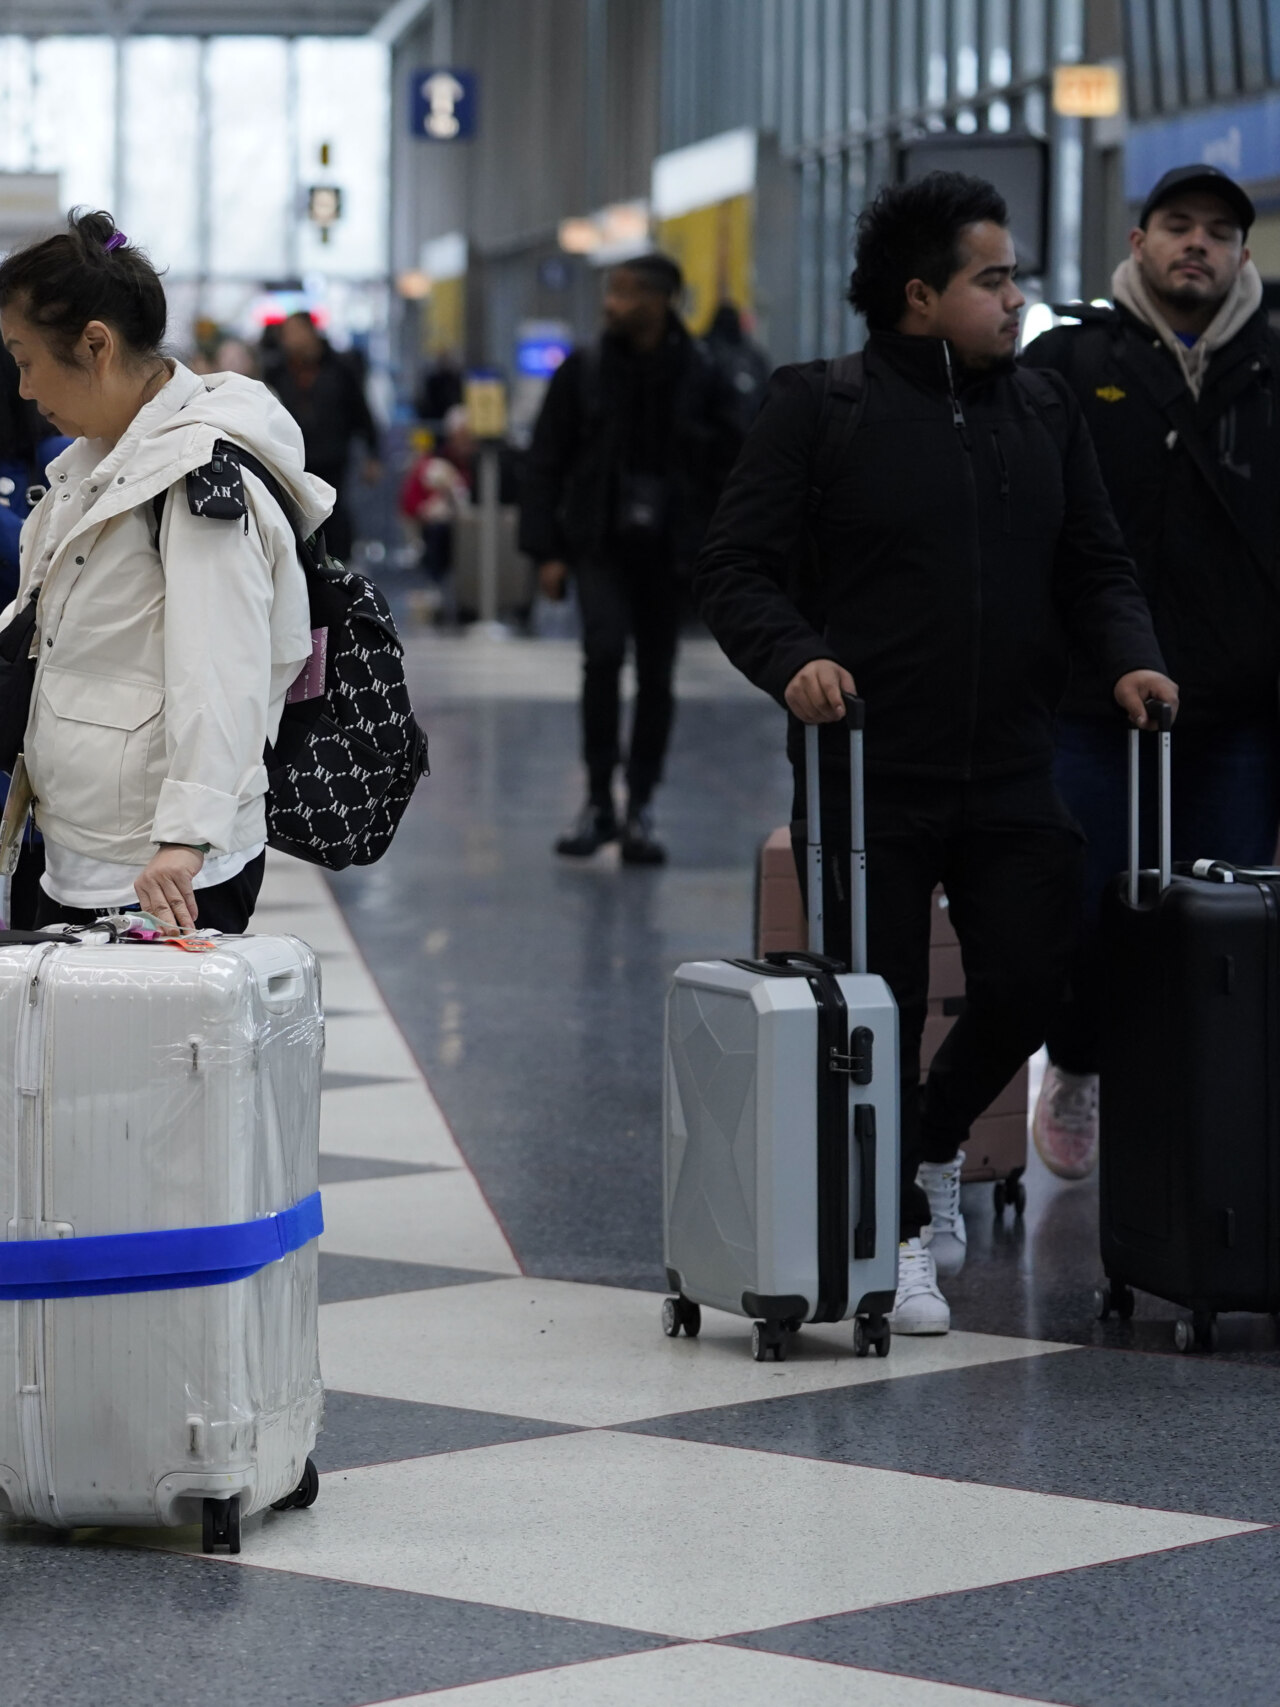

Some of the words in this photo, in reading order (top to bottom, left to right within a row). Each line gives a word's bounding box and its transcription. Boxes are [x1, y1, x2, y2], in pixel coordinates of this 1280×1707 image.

[212, 485, 231, 498] NY
[350, 643, 370, 663] NY
[339, 680, 358, 700] NY
[370, 678, 390, 697] NY
[356, 716, 375, 735] NY
[389, 711, 407, 728] NY
[313, 764, 333, 784] NY
[349, 764, 370, 783] NY
[293, 801, 314, 820] NY
[329, 800, 349, 819] NY
[308, 835, 330, 850] NY
